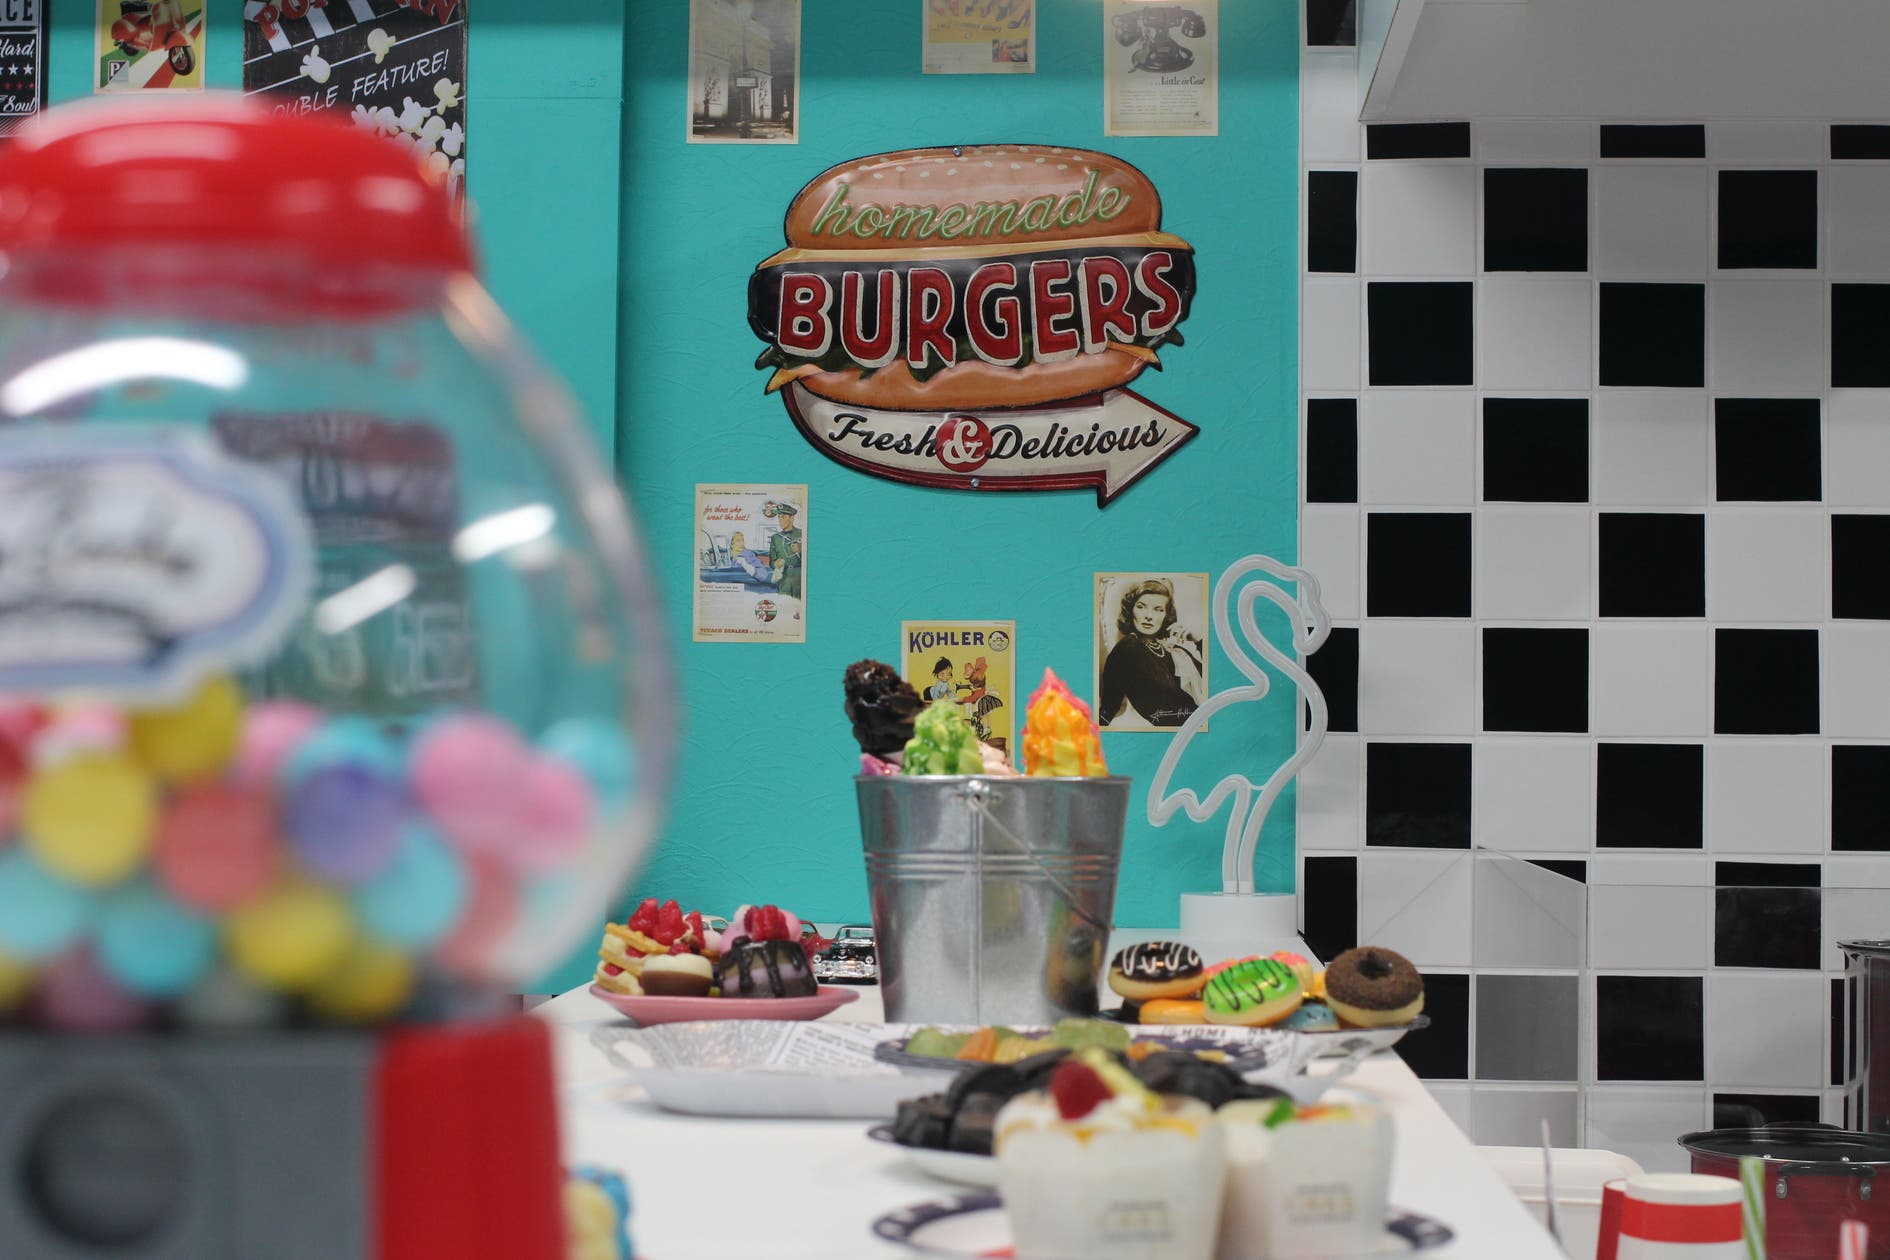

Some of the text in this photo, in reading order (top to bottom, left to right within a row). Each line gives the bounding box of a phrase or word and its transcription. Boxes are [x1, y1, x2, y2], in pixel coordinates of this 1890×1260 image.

[0, 0, 33, 21] CE
[3, 95, 37, 112] Soul
[271, 49, 450, 121] OUBLE FEATURE!
[811, 171, 1131, 239] homemade
[780, 253, 1181, 367] BURGERS
[829, 413, 1168, 464] Fresh & Delicious
[909, 631, 984, 653] KÖHLER
